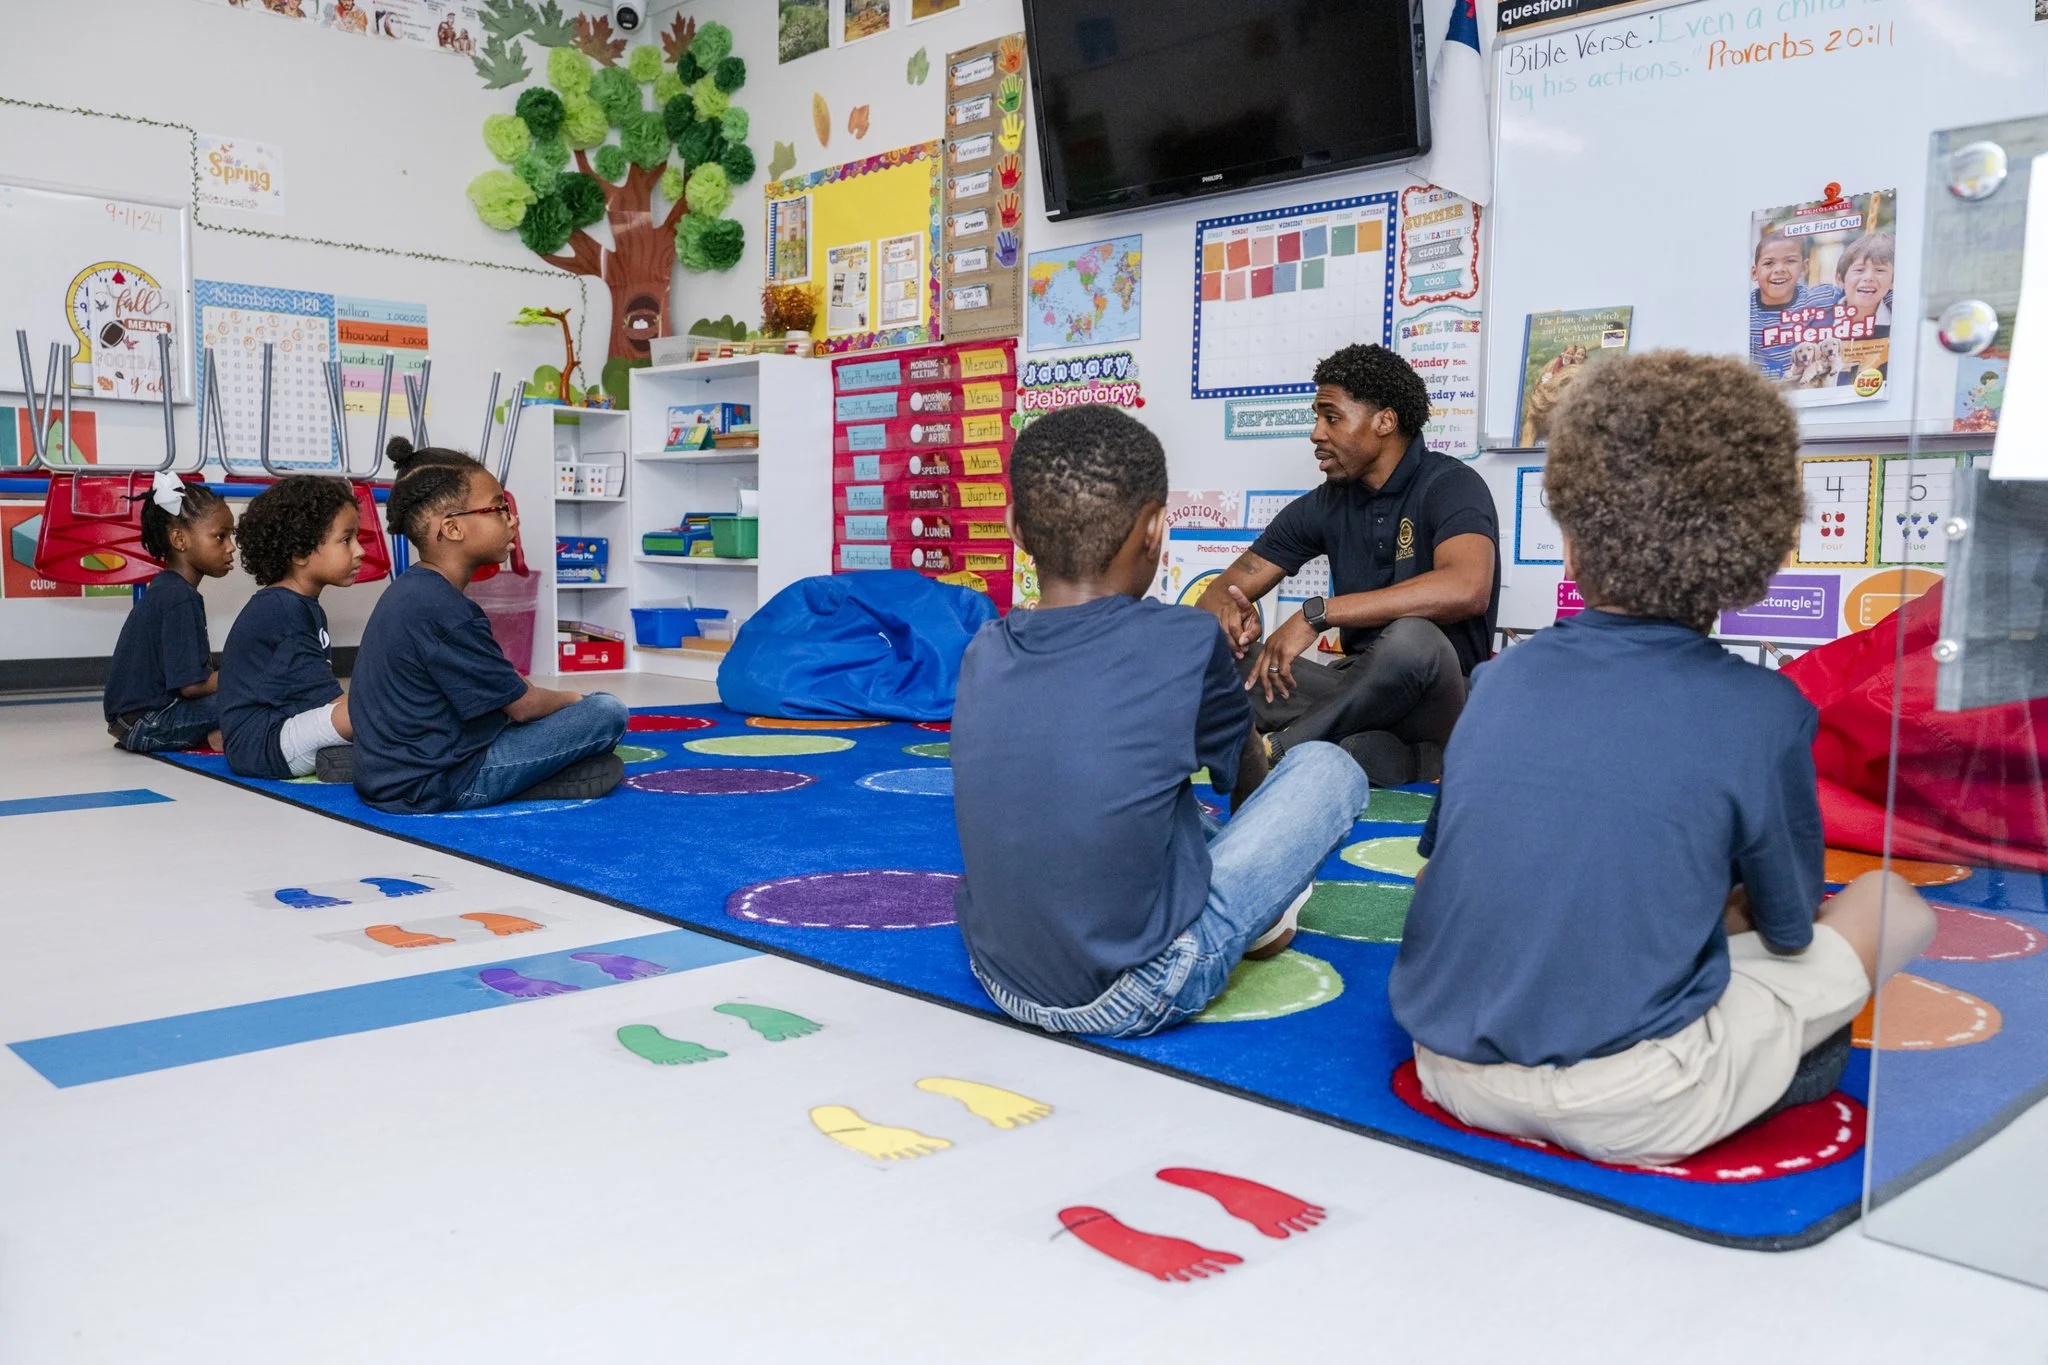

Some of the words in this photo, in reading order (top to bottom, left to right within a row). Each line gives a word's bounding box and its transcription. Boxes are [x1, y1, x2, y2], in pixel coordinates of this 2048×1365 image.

[1502, 0, 1573, 25] question
[1506, 39, 1568, 75] Bible
[1656, 10, 1735, 43] Even
[1746, 8, 1762, 30] a
[1708, 33, 1815, 71] Proverbs
[1824, 20, 1894, 52] 20:11
[1509, 79, 1534, 111] by
[1543, 73, 1577, 98] his
[208, 151, 271, 192] Spring
[1802, 202, 1852, 215] SCHOLASTIC
[1404, 204, 1464, 231] SUMMER
[1787, 224, 1811, 236] Let's
[1814, 220, 1837, 231] Find
[1840, 217, 1860, 227] Out
[1424, 228, 1461, 241] WEATHER
[1418, 244, 1451, 258] CLOUDY
[1430, 262, 1446, 271] AND
[1424, 276, 1446, 286] COOL
[211, 287, 287, 310] Numbers
[338, 303, 369, 318] million
[1781, 308, 1825, 324] Let's
[1833, 306, 1858, 318] Be
[1538, 317, 1553, 326] The
[1579, 313, 1591, 323] the
[1593, 311, 1620, 322] Witch
[340, 326, 389, 343] thousand
[1402, 322, 1433, 339] DAYS
[1443, 320, 1481, 333] WEEK
[1542, 326, 1556, 335] and
[1558, 325, 1571, 334] the
[1572, 322, 1614, 333] Wardrobe
[1763, 315, 1876, 347] Friends!
[1411, 340, 1449, 353] Sunday
[340, 348, 384, 366] hundred
[910, 358, 938, 369] MORNING
[965, 356, 1004, 372] Mercury
[1410, 357, 1449, 369] Monday
[840, 371, 863, 385] North
[864, 368, 897, 382] America
[911, 369, 938, 379] MEETING
[1026, 355, 1129, 384] January
[1857, 378, 1880, 388] BIG
[922, 391, 952, 402] MORNING
[970, 392, 1000, 403] Venus
[1026, 384, 1137, 409] February
[839, 404, 863, 417] South
[864, 401, 894, 414] America
[924, 402, 943, 412] WORK
[922, 424, 952, 433] LANGUAGE
[968, 422, 1001, 437] Earth
[852, 431, 883, 448] Europe
[928, 433, 946, 442] ARTS
[859, 463, 878, 474] Asia
[969, 455, 999, 470] Mars
[921, 466, 950, 475] SPECIALS
[1826, 475, 1845, 503] 4
[1908, 474, 1927, 501] 5
[852, 492, 882, 505] Africa
[910, 490, 938, 500] READING
[965, 487, 1004, 505] Jupiter
[1165, 505, 1228, 528] EMOTIONS
[851, 524, 885, 536] Australia
[924, 528, 951, 538] LUNCH
[1197, 544, 1230, 553] Prediction
[1536, 542, 1555, 550] Zero
[1821, 542, 1844, 550] Four
[845, 554, 889, 566] Antarctica
[926, 550, 943, 559] READ
[925, 560, 945, 569] ALOUD
